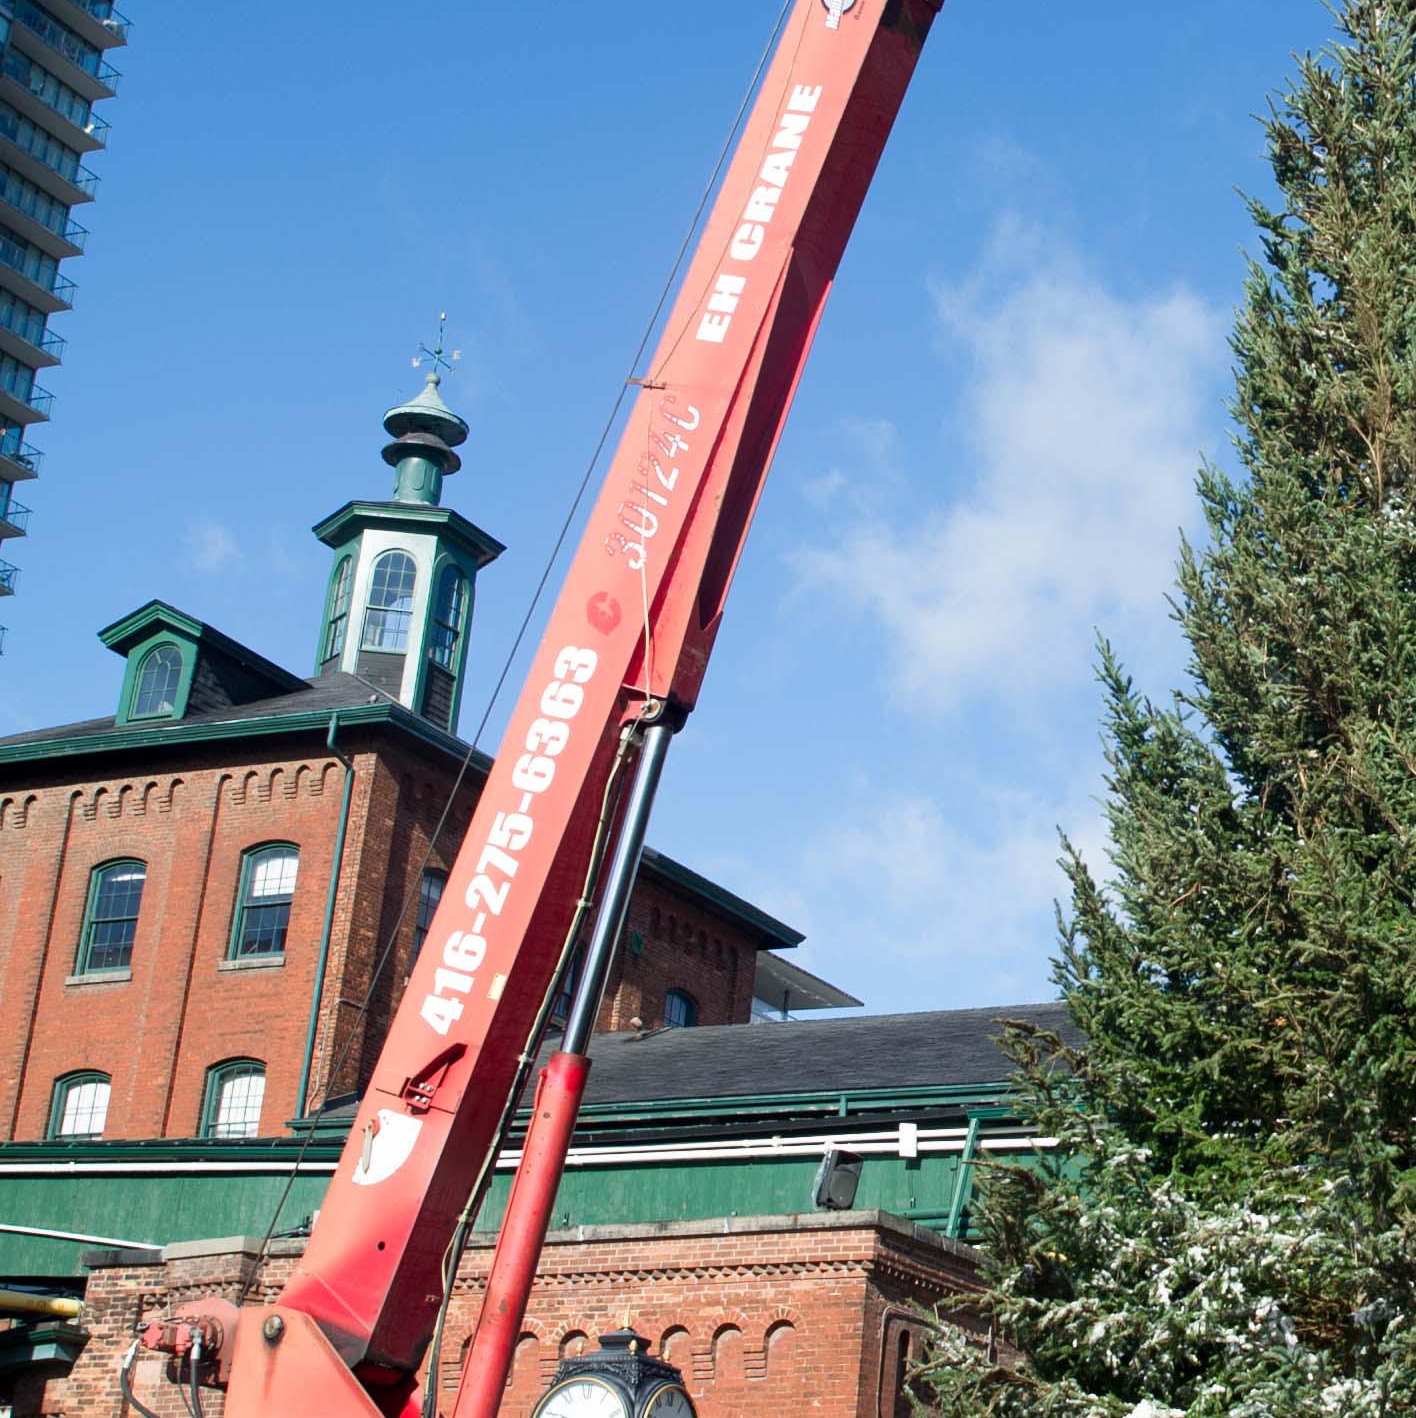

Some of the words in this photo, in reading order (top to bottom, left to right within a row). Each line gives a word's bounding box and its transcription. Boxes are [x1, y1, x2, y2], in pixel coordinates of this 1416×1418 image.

[696, 274, 746, 343] EH
[730, 85, 822, 260] CRANE
[419, 645, 599, 1036] 416-275-6363
